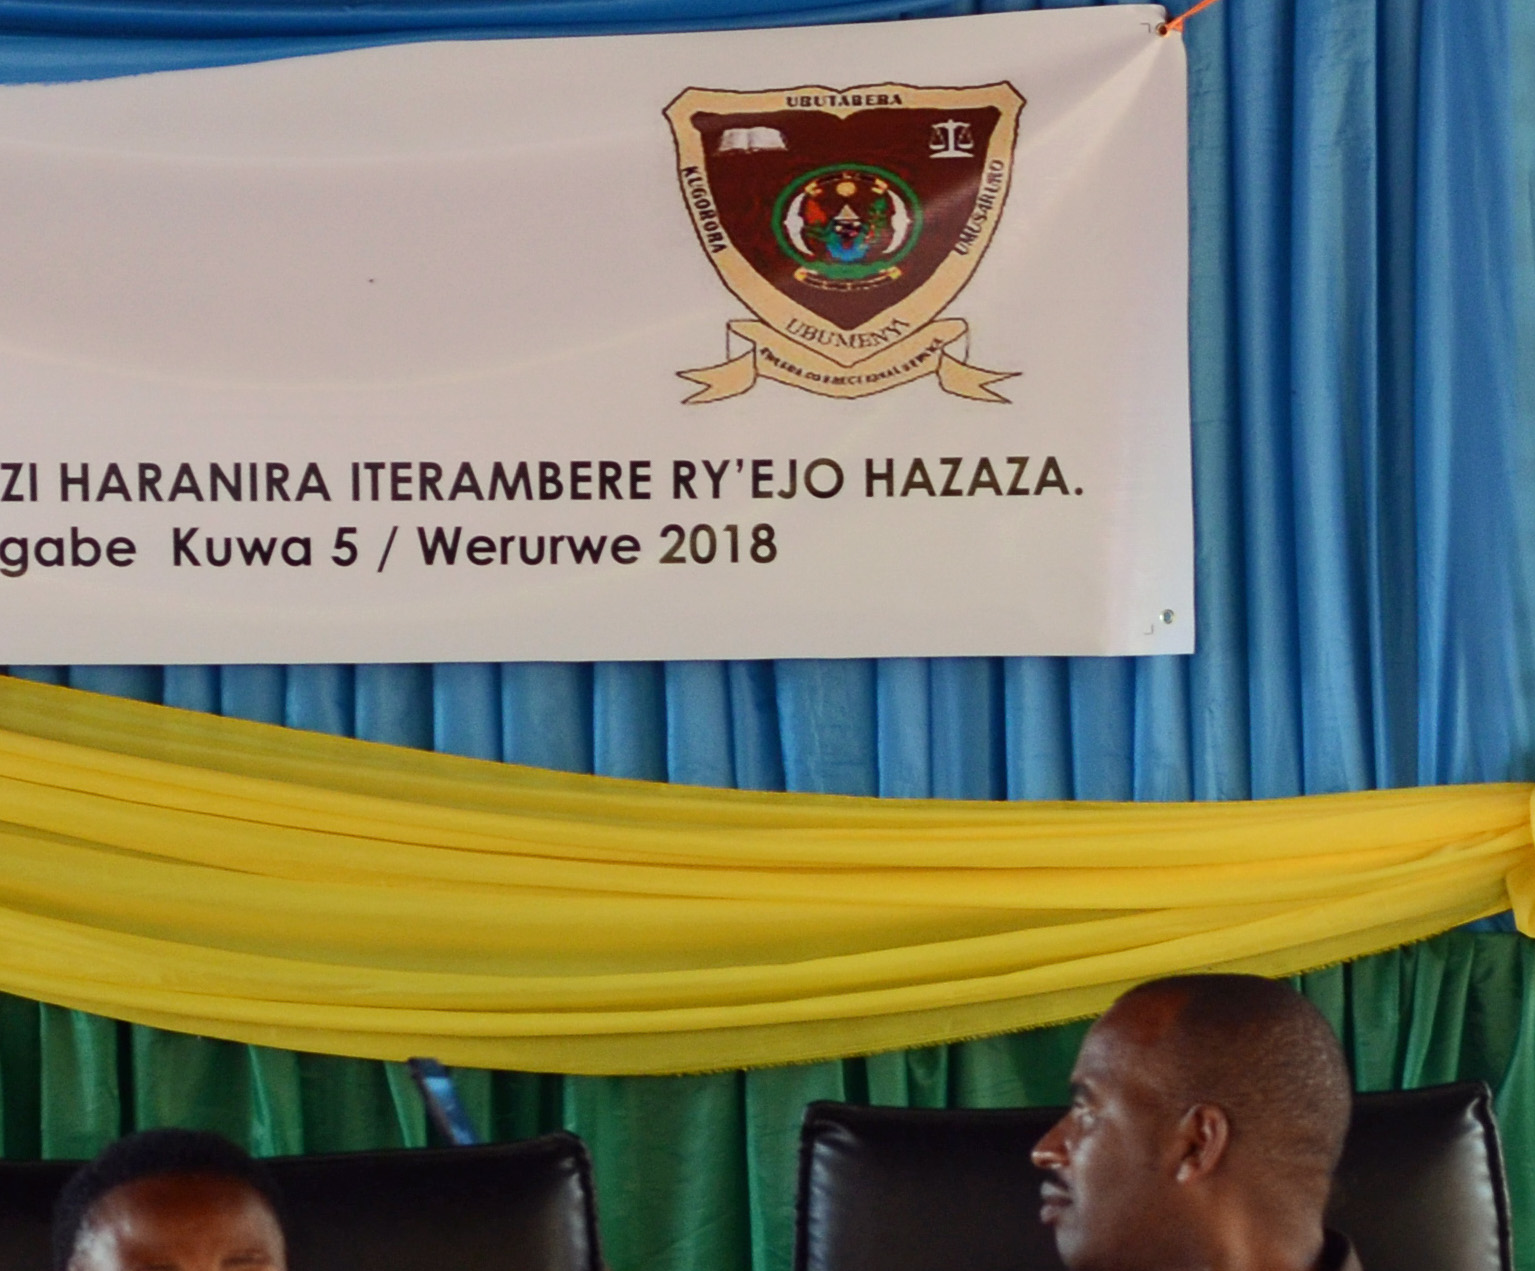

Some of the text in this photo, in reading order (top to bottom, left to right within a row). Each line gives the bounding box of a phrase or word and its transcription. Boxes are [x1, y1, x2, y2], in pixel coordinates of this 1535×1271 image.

[786, 93, 903, 108] UBUTABERA
[680, 165, 728, 255] KUGORORA
[785, 317, 912, 349] UBUMENYI
[60, 462, 332, 502] HARANIRA
[351, 460, 651, 502] ITERAMBERE
[865, 456, 1084, 498] HAZAZA.
[172, 527, 312, 567] Kuwa
[331, 526, 358, 567] 5
[377, 525, 399, 573] /
[417, 526, 641, 566] Werurwe
[659, 523, 778, 565] 2018
